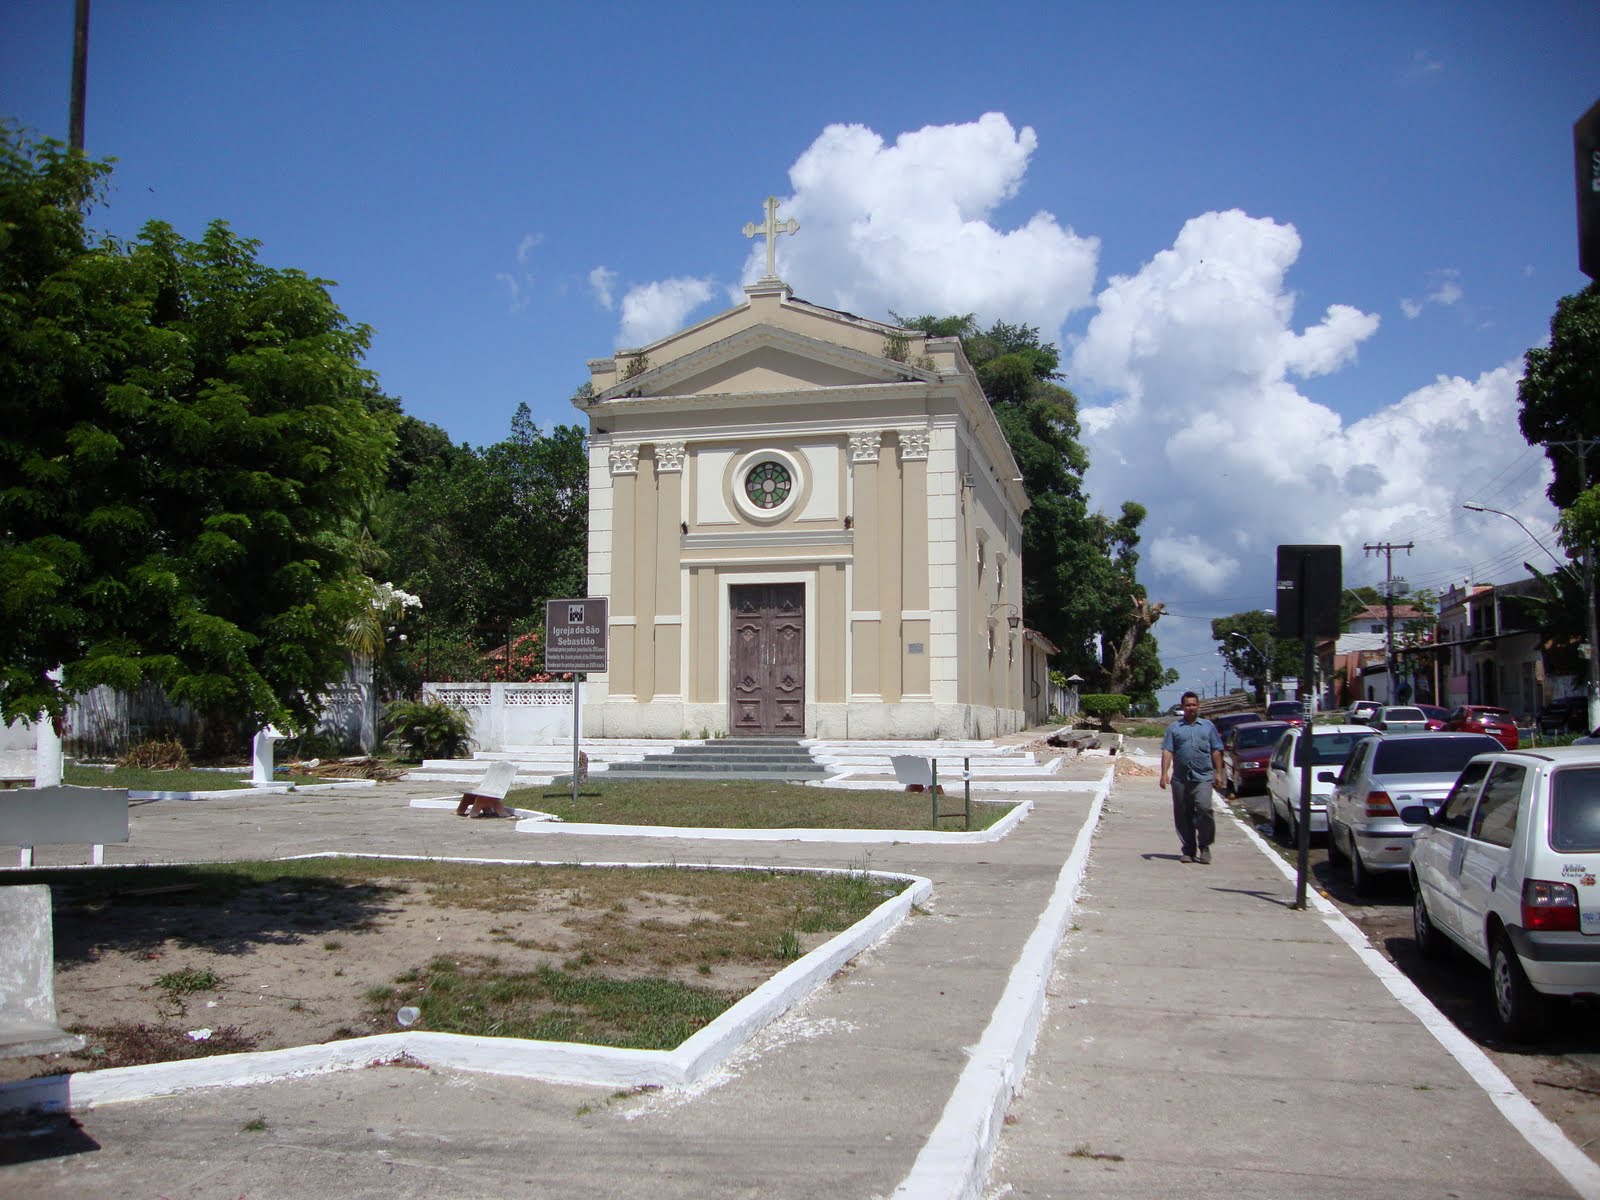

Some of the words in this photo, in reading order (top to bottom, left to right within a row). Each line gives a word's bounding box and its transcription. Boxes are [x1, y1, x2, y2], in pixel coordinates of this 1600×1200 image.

[553, 626, 574, 636] Igreja
[575, 626, 585, 634] de
[585, 625, 600, 634] São
[557, 637, 595, 646] Sebastião
